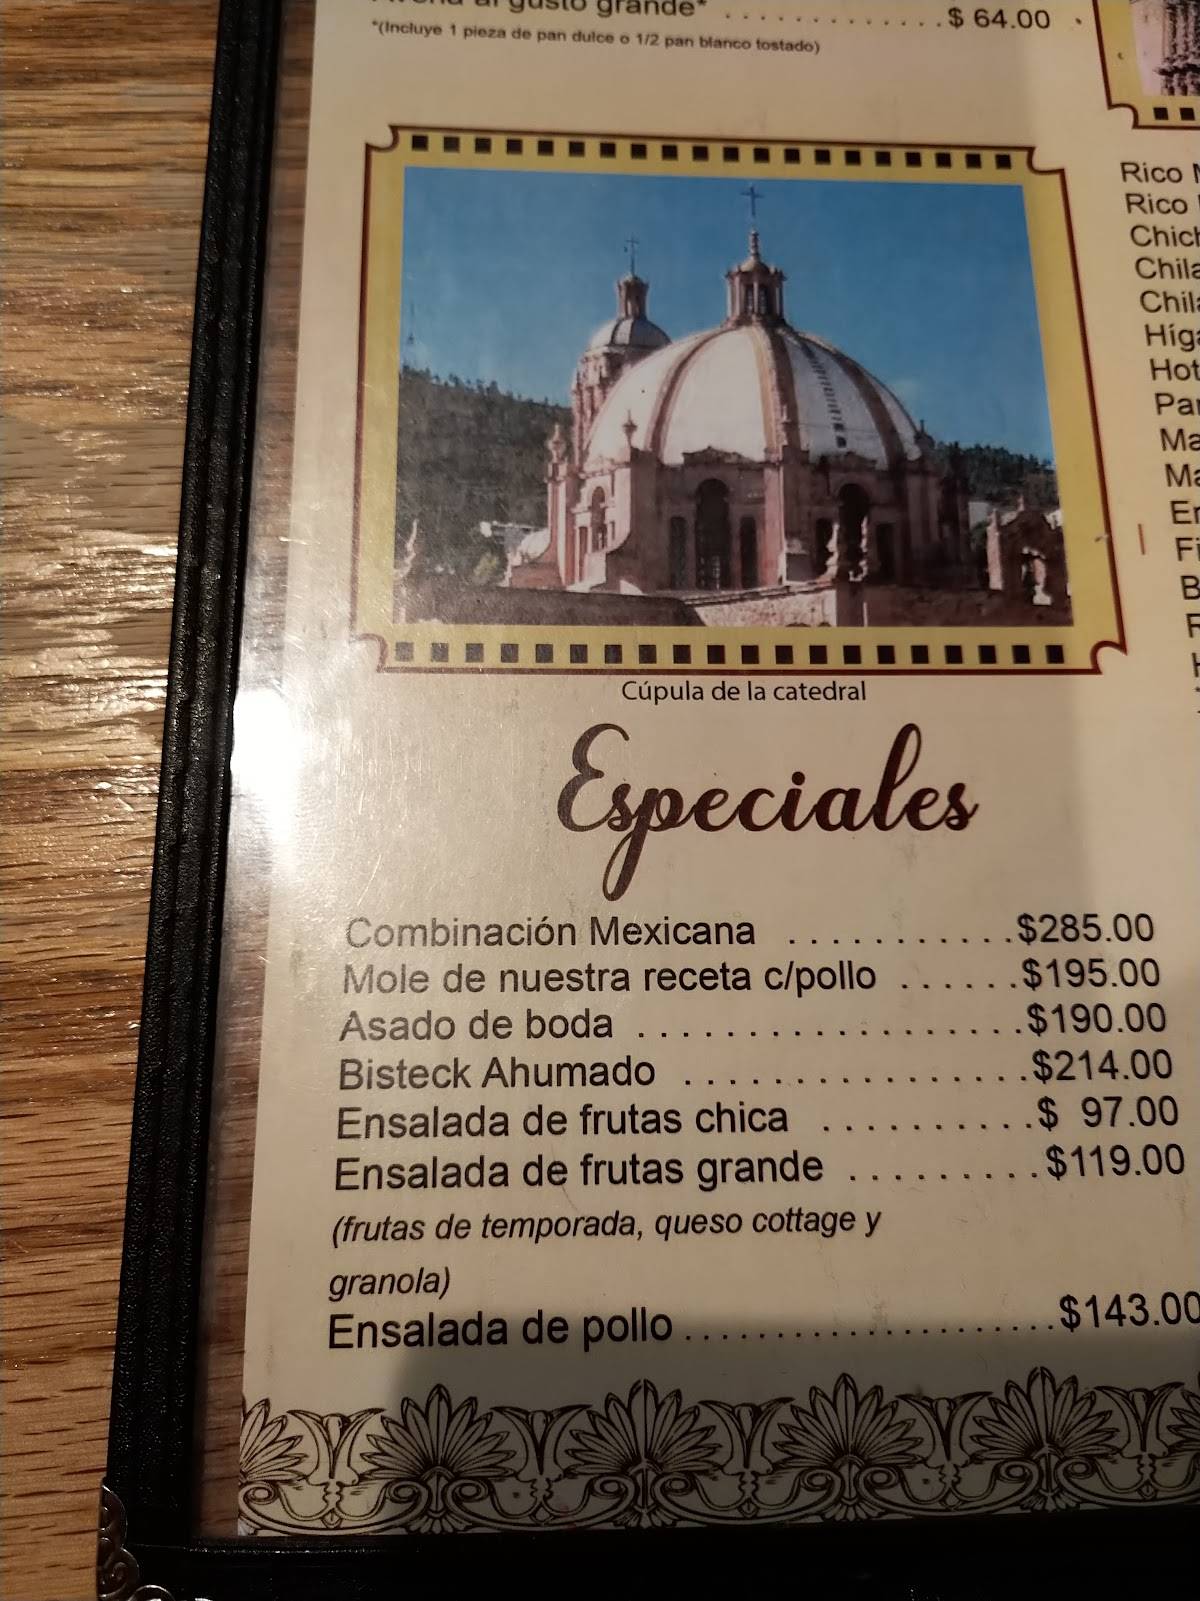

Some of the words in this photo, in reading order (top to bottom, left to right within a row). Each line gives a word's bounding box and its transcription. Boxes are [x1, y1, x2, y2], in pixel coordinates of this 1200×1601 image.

[948, 7, 964, 29] $
[974, 8, 1050, 29] 64.00
[449, 24, 457, 36] 1
[463, 26, 507, 40] pieza
[511, 28, 532, 40] de
[536, 31, 567, 43] pan
[571, 30, 615, 44] dulce
[619, 35, 631, 45] o
[636, 33, 660, 46] 1/2
[664, 37, 695, 49] pan
[698, 36, 752, 50] blanco
[755, 39, 821, 55] tostado)
[1120, 162, 1183, 183] Rico
[1125, 193, 1188, 214] Rico
[1130, 224, 1200, 247] Chic
[1140, 290, 1200, 313] Chil
[1145, 323, 1200, 352] Híg
[1155, 393, 1200, 416] Pa
[622, 680, 704, 705] Cúpula
[712, 681, 740, 701] de
[748, 681, 765, 701] la
[773, 680, 866, 701] catedral
[557, 723, 979, 901] Especiales
[346, 916, 576, 948] Combinación
[591, 916, 755, 945] Mexicana
[1017, 913, 1154, 946] $285.00
[344, 964, 429, 993] Mole
[443, 963, 485, 993] de
[500, 963, 630, 992] nuestra
[645, 961, 751, 991] receta
[765, 960, 876, 998] c/pollo
[1022, 958, 1160, 991] $195.00
[339, 1010, 455, 1041] Asado
[469, 1009, 512, 1039] de
[527, 1008, 612, 1039] boda
[1027, 1002, 1167, 1037] $190.00
[340, 1057, 471, 1090] Bisteck
[481, 1055, 655, 1088] Ahumado
[1032, 1049, 1172, 1084] $214.00
[338, 1105, 509, 1139] Ensalada
[523, 1104, 567, 1136] de
[580, 1103, 682, 1135] frutas
[696, 1101, 788, 1133] chica
[1037, 1096, 1059, 1132] $
[1081, 1095, 1178, 1127] 97.00
[335, 1155, 509, 1190] Ensalada
[523, 1154, 568, 1186] de
[580, 1153, 683, 1186] frutas
[697, 1149, 823, 1192] grande
[1046, 1144, 1185, 1181] $119.00
[333, 1216, 425, 1248] (frutas
[435, 1213, 471, 1240] de
[482, 1210, 642, 1244] temporada,
[655, 1213, 742, 1242] queso
[752, 1207, 856, 1238] cottage
[865, 1211, 882, 1238] y
[328, 1266, 450, 1302] granola)
[329, 1311, 507, 1349] Ensalada
[522, 1309, 569, 1344] de
[584, 1306, 672, 1352] pollo
[1059, 1291, 1200, 1333] $143.00
